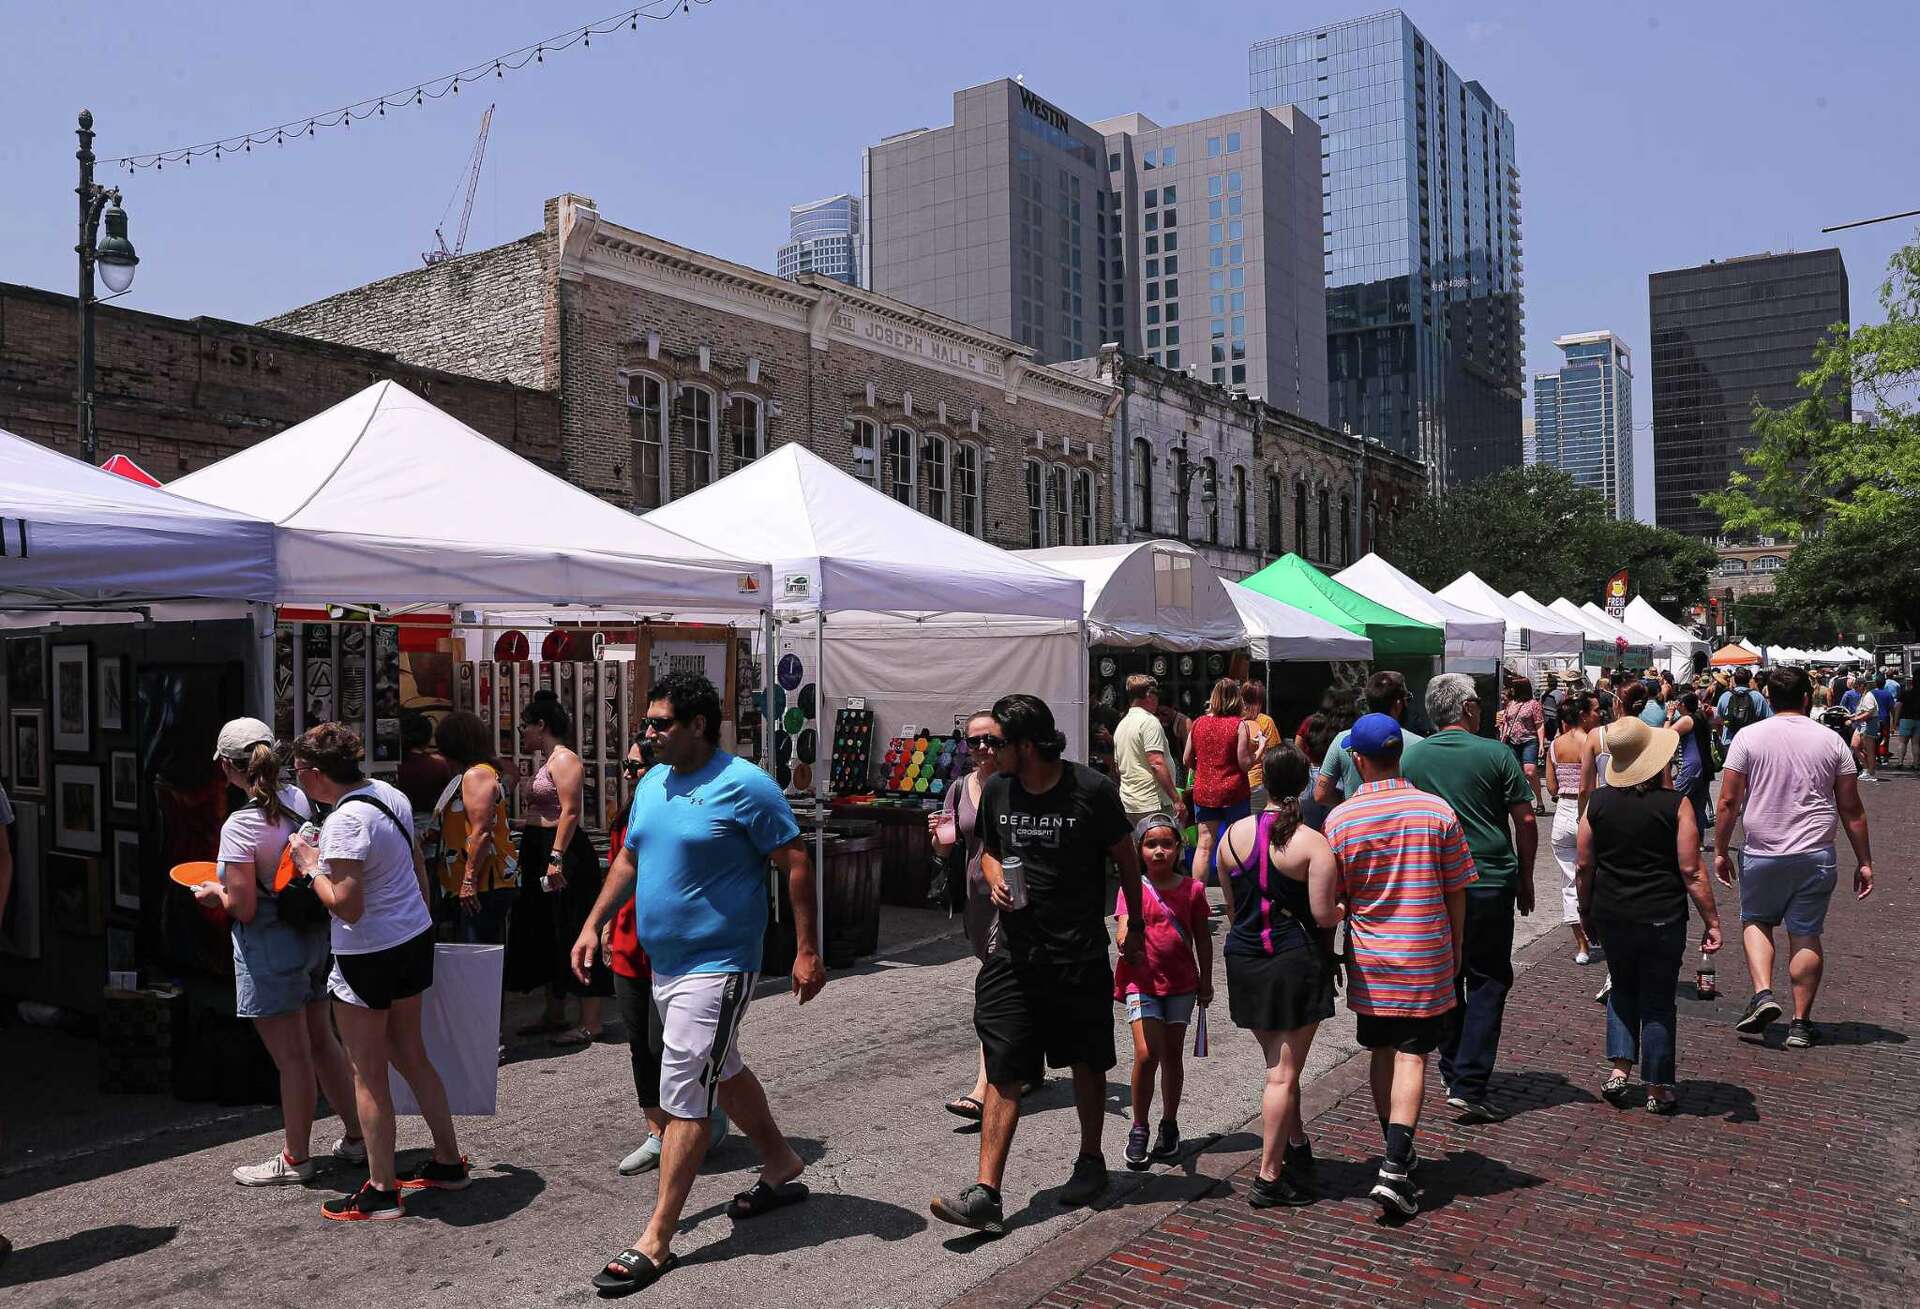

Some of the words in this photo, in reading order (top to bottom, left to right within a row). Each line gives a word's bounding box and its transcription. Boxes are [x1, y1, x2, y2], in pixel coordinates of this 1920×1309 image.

[1019, 86, 1069, 134] WESTIN
[864, 322, 924, 354] JOSEPH
[931, 341, 977, 370] NALLE
[999, 814, 1077, 828] DEFIANT
[1016, 828, 1054, 837] CROSSFIT
